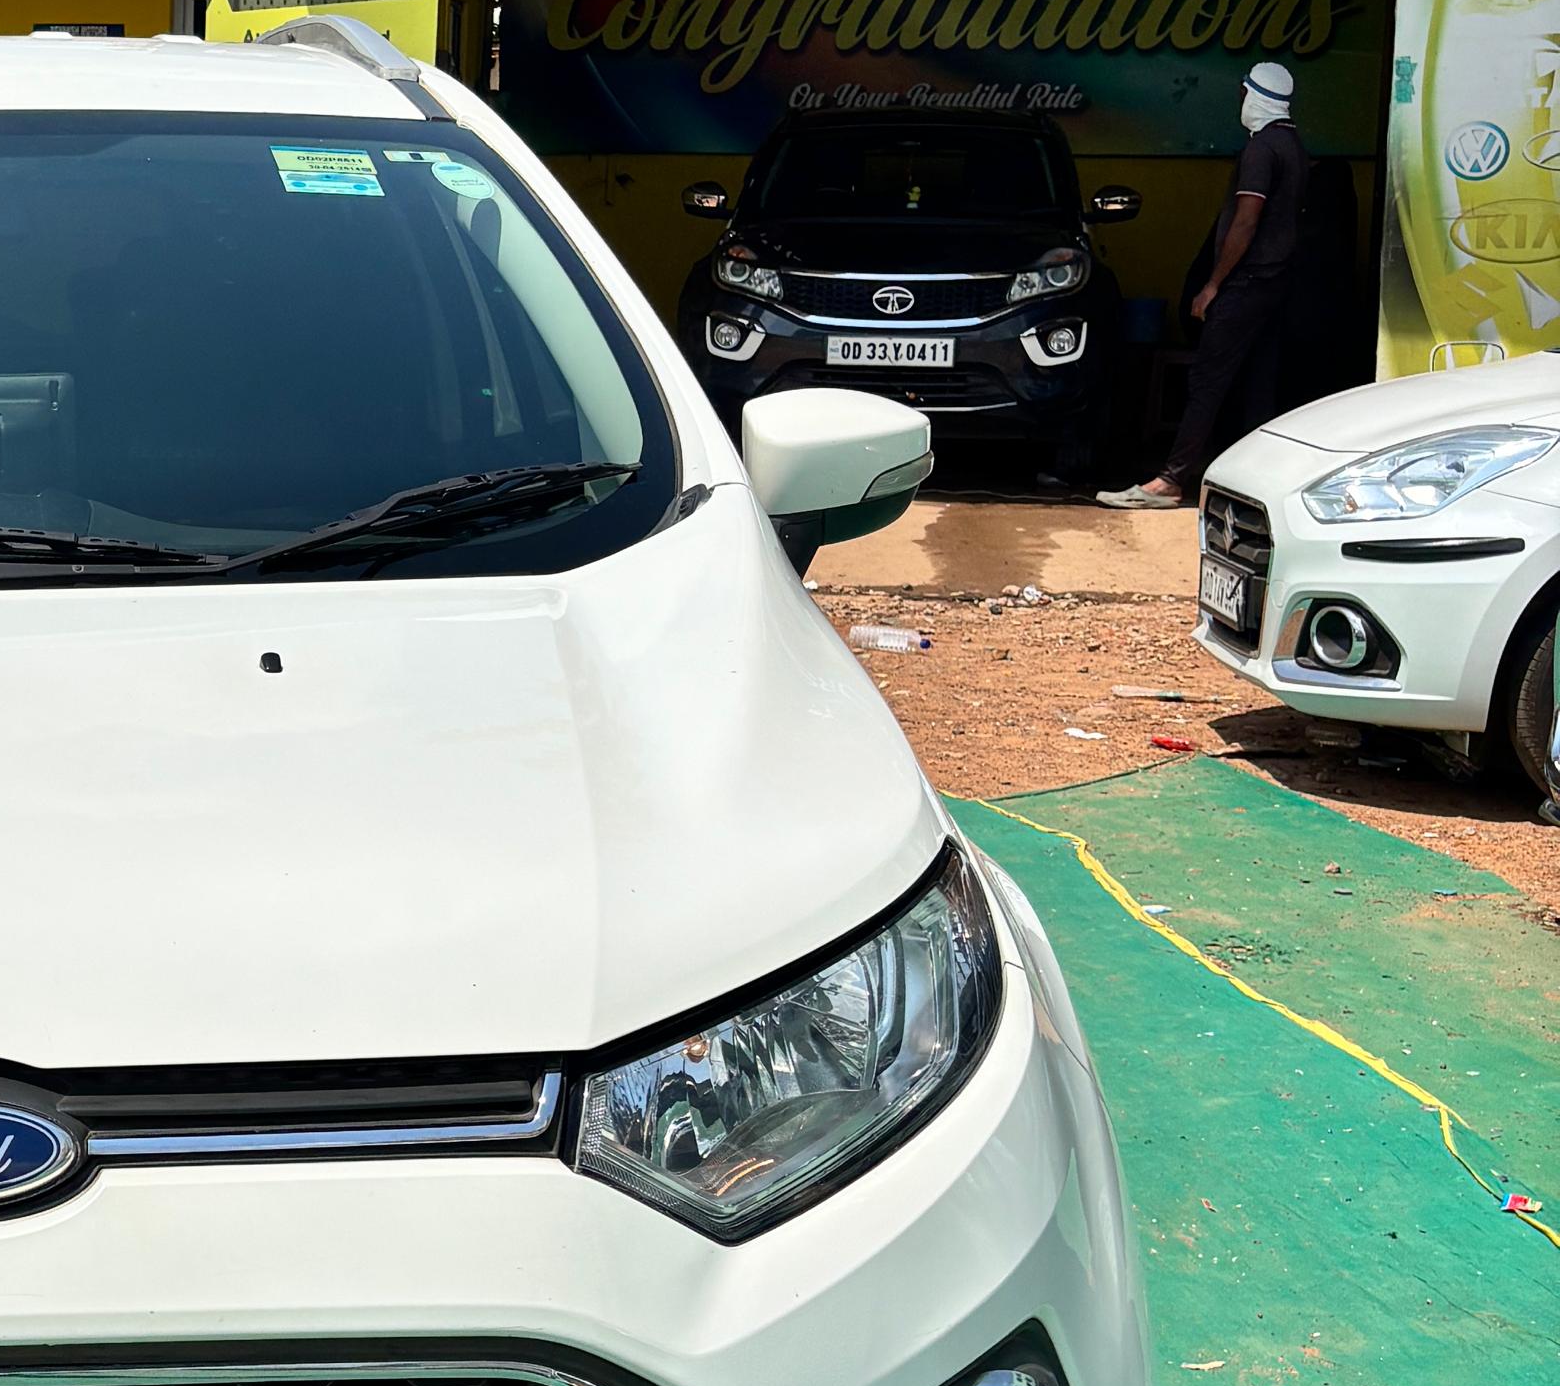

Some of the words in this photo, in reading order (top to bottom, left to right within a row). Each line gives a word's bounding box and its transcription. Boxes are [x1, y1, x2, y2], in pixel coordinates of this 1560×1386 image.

[788, 82, 826, 110] On
[832, 82, 897, 111] Your
[905, 82, 1023, 110] Beautiful
[1025, 82, 1085, 110] Ride
